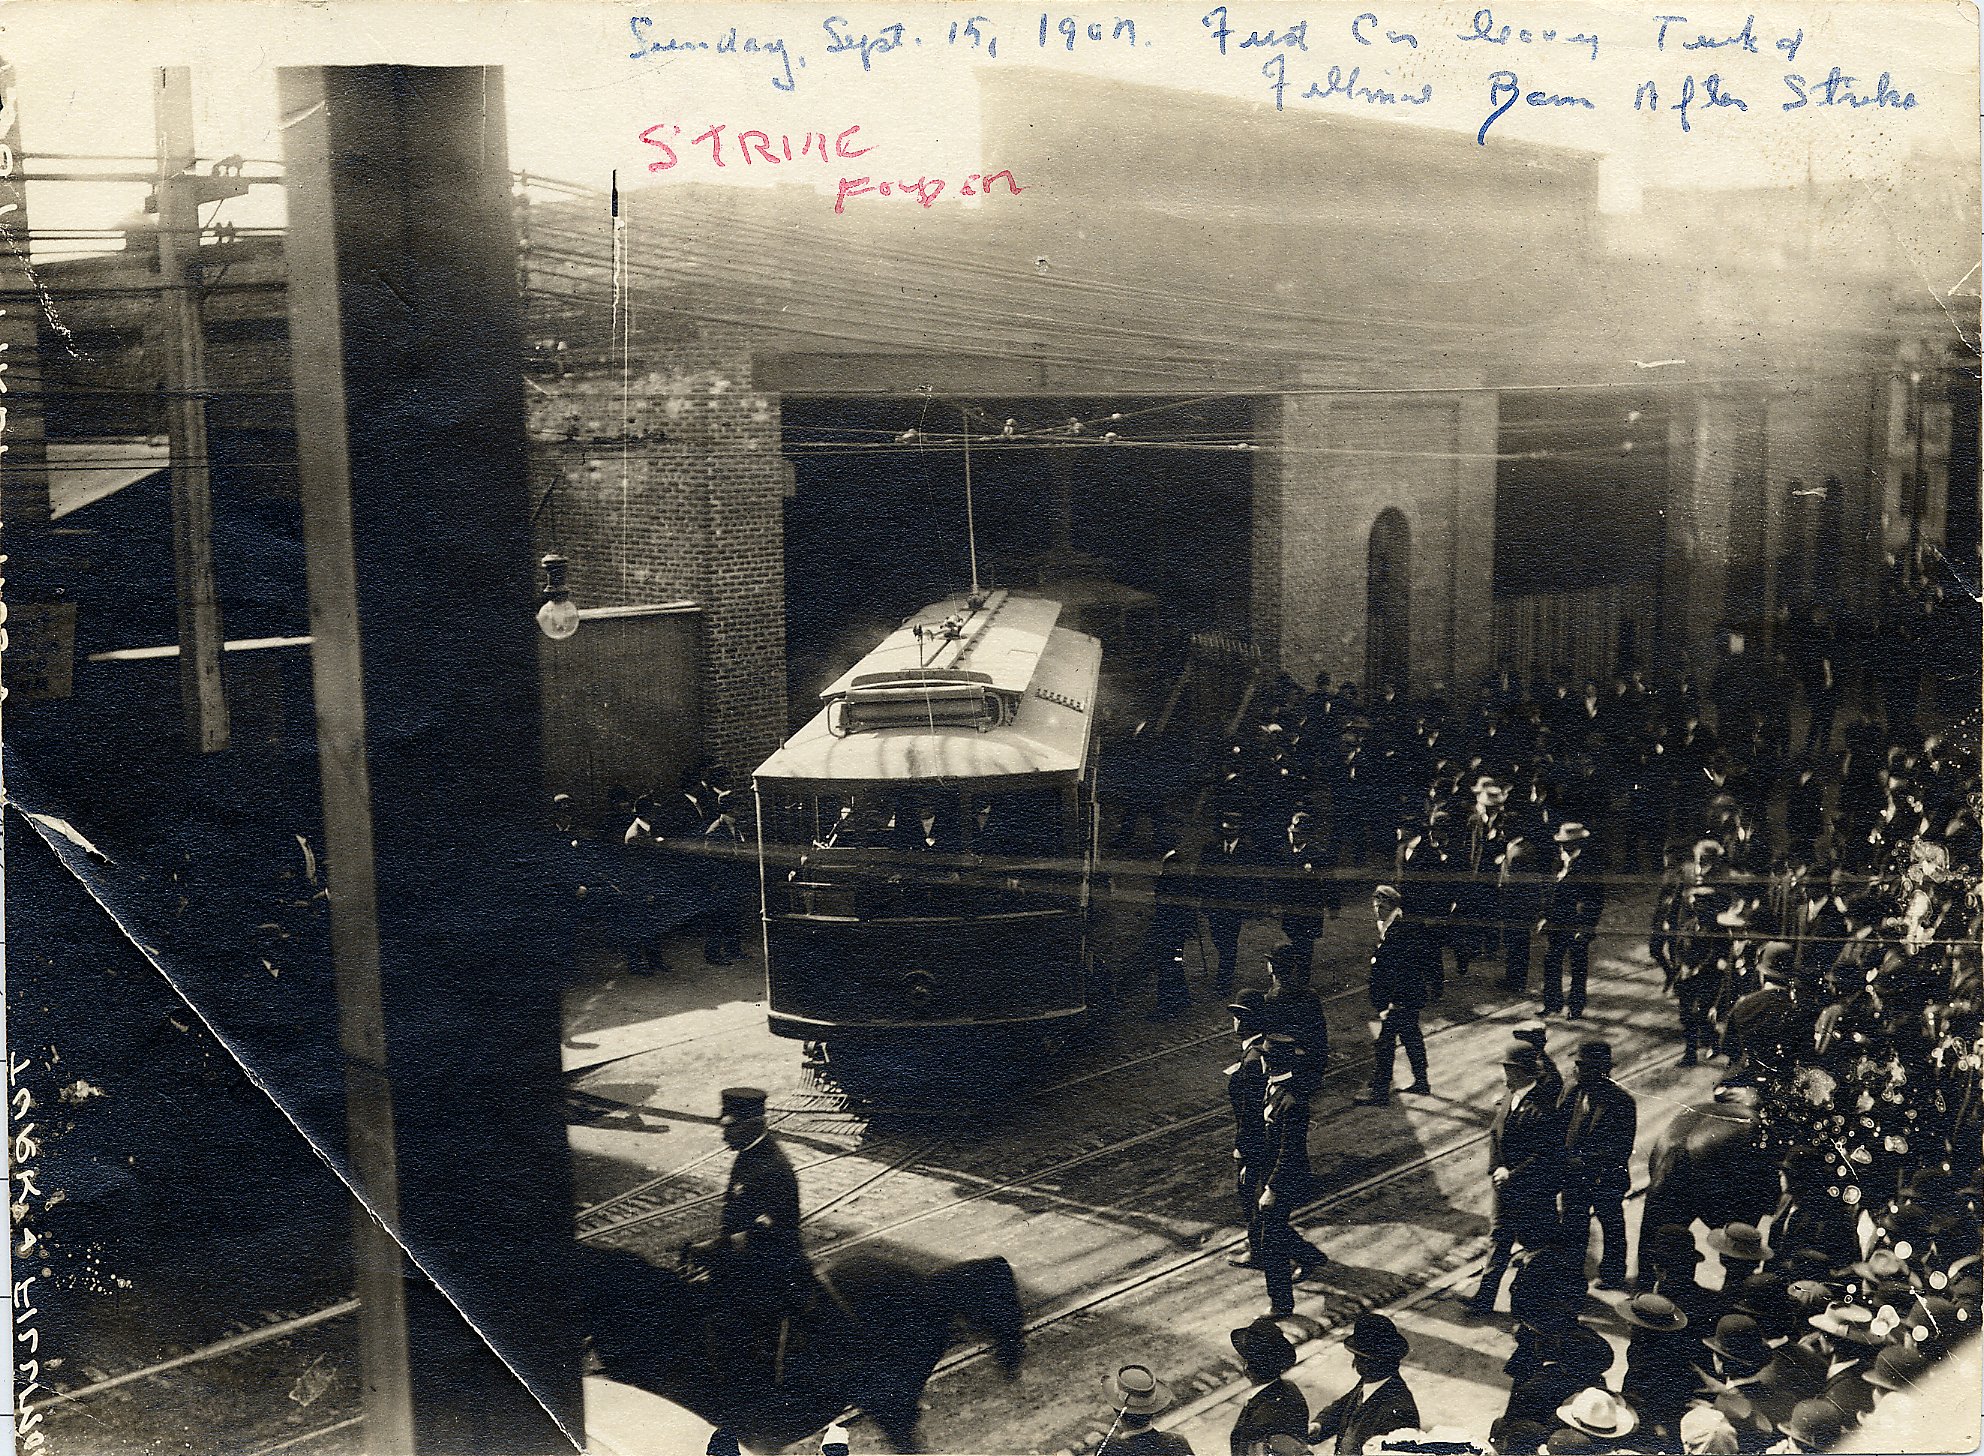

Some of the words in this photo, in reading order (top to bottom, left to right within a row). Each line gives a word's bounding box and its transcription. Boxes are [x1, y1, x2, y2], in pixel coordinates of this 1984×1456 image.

[629, 16, 806, 91] Sunday,
[822, 15, 922, 71] Sept.
[948, 15, 997, 58] 15,
